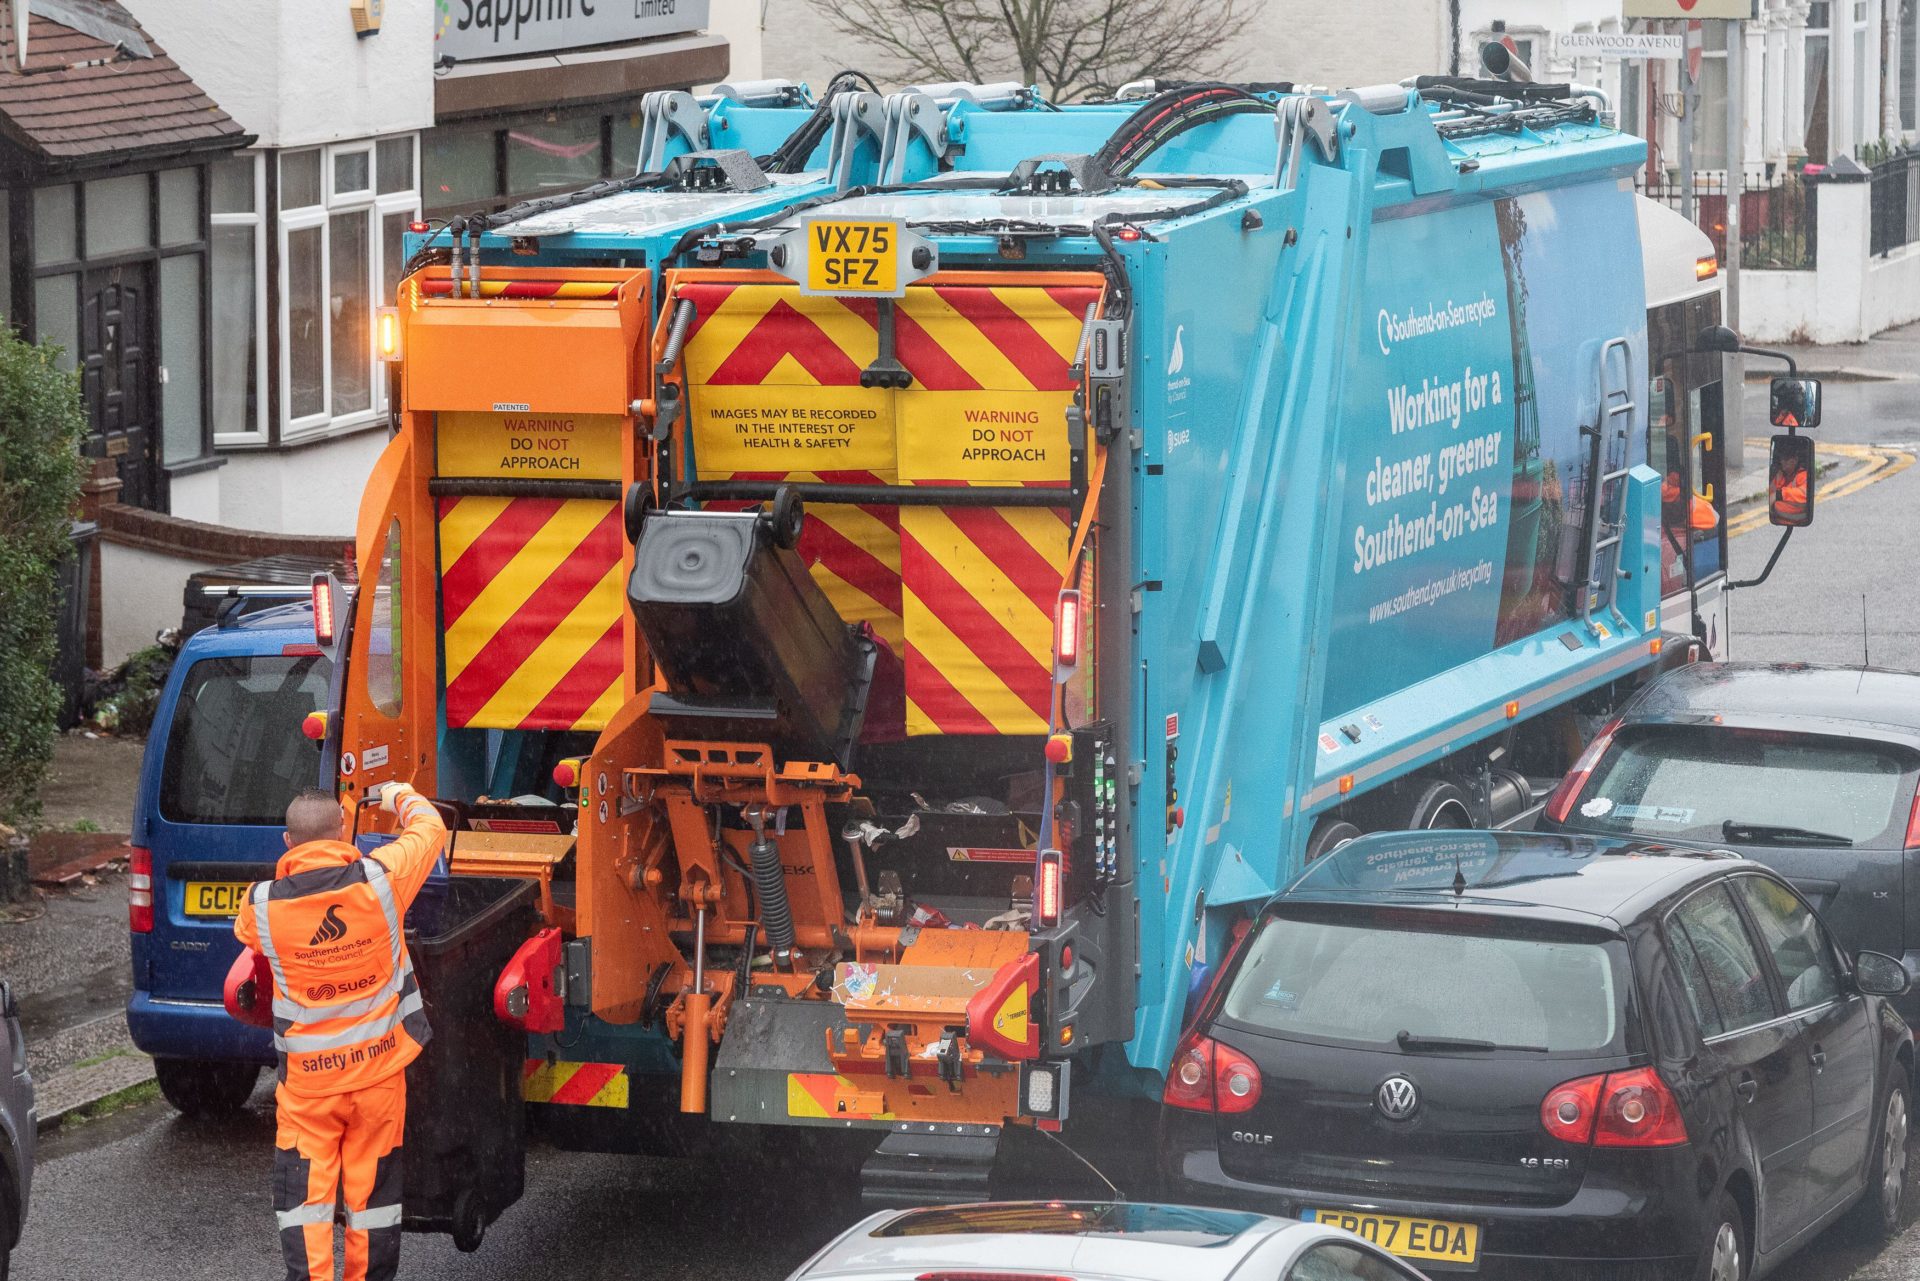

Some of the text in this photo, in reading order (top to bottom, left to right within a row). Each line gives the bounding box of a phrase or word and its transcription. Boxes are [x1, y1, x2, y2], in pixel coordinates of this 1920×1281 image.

[635, 0, 675, 19] Limited
[1561, 35, 1681, 48] GLENWOOD AVENU
[816, 225, 889, 254] VX75
[825, 257, 879, 286] SFZ
[1393, 291, 1496, 342] Southend-on-Sea recycles
[1388, 366, 1501, 435] Working for a
[710, 408, 877, 420] IMAGES MAY BE RECORDED
[964, 410, 1039, 424] WARNING
[503, 419, 575, 432] WARNING
[735, 423, 856, 434] IN THE INTEREST OF
[511, 437, 569, 451] DO NOT
[744, 438, 851, 448] HEALTH & SAFETY
[972, 429, 1034, 443] DO NOT
[500, 456, 580, 470] APPROACH
[962, 448, 1046, 462] APPROACH
[1366, 430, 1501, 506] cleaner, greener
[1353, 485, 1497, 574] Southend-on-Sea
[1369, 558, 1493, 624] www.southend.gov.uk/recycling
[171, 941, 210, 951] CADDY
[294, 938, 372, 960] Southend-on-Sea
[308, 949, 363, 967] City Council
[338, 974, 377, 993] suez
[302, 1032, 396, 1072] safety in mind
[1232, 1131, 1273, 1145] GOLF
[1543, 1158, 1569, 1169] FSI
[1408, 1222, 1467, 1256] EOA
